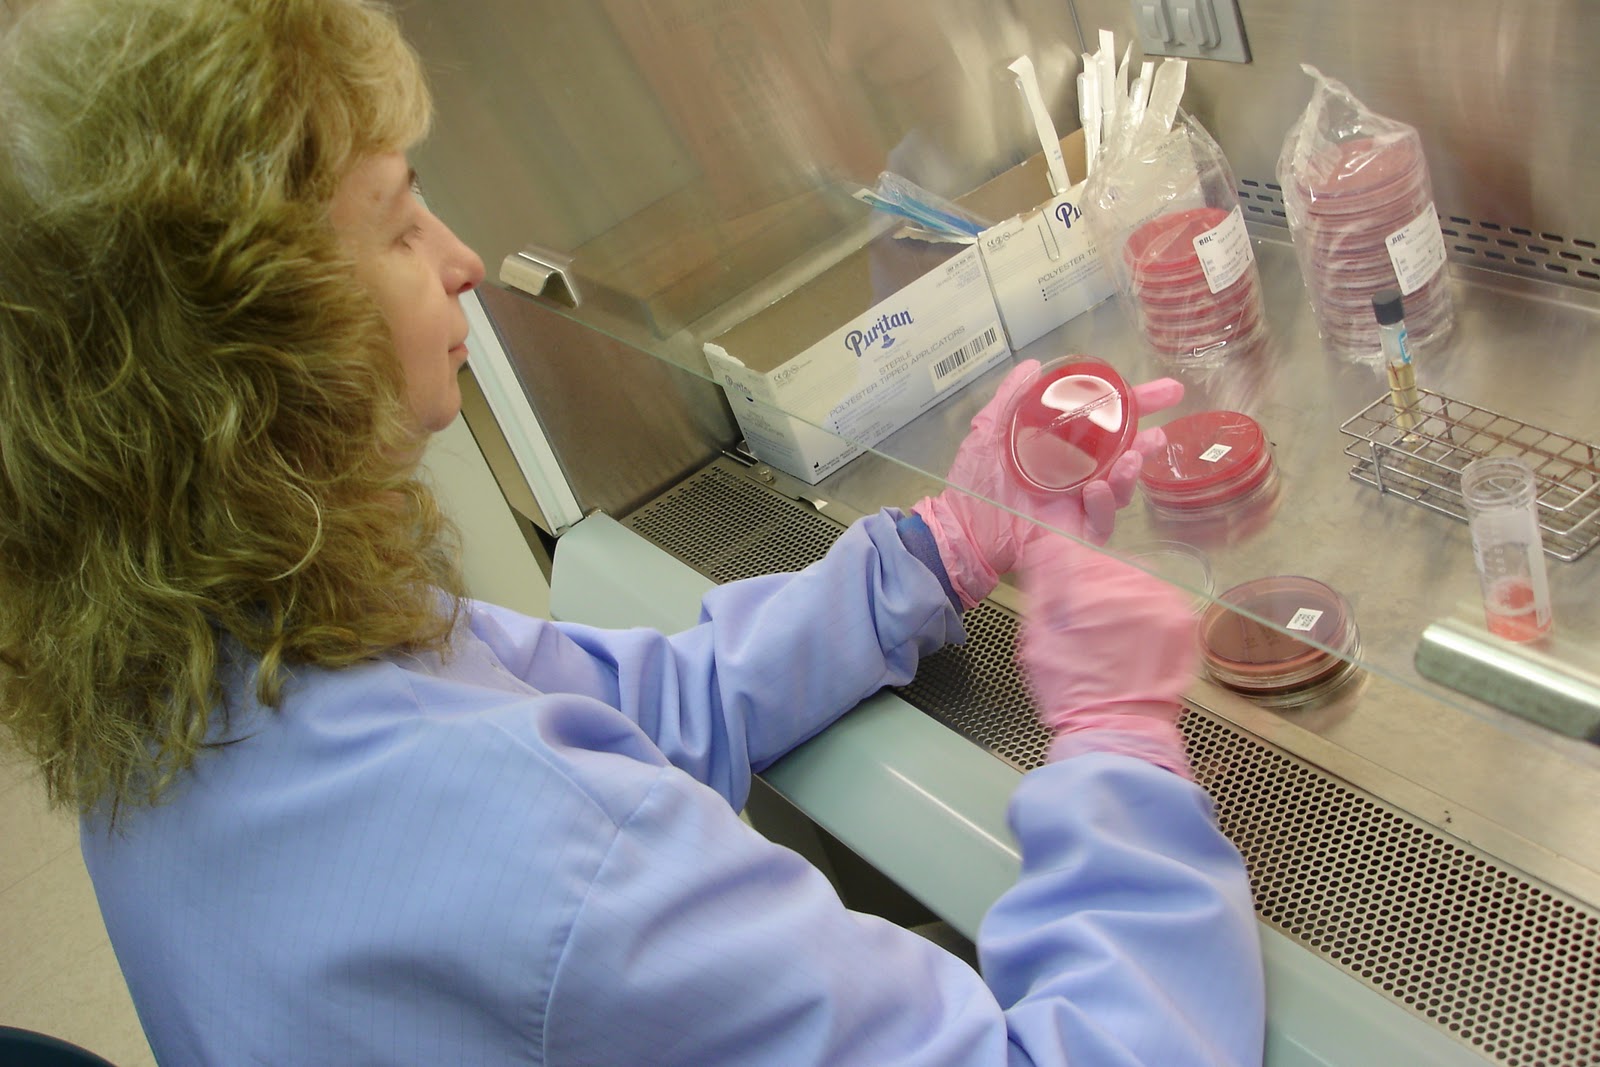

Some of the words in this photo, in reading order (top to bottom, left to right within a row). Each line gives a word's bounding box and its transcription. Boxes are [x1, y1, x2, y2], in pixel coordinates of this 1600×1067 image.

[1038, 253, 1085, 284] POLYESTER
[844, 310, 915, 358] Puritan
[829, 382, 878, 418] POLYESTER
[880, 363, 909, 385] TIPPED
[911, 325, 966, 365] APPLICATORS
[879, 350, 913, 375] STERILE
